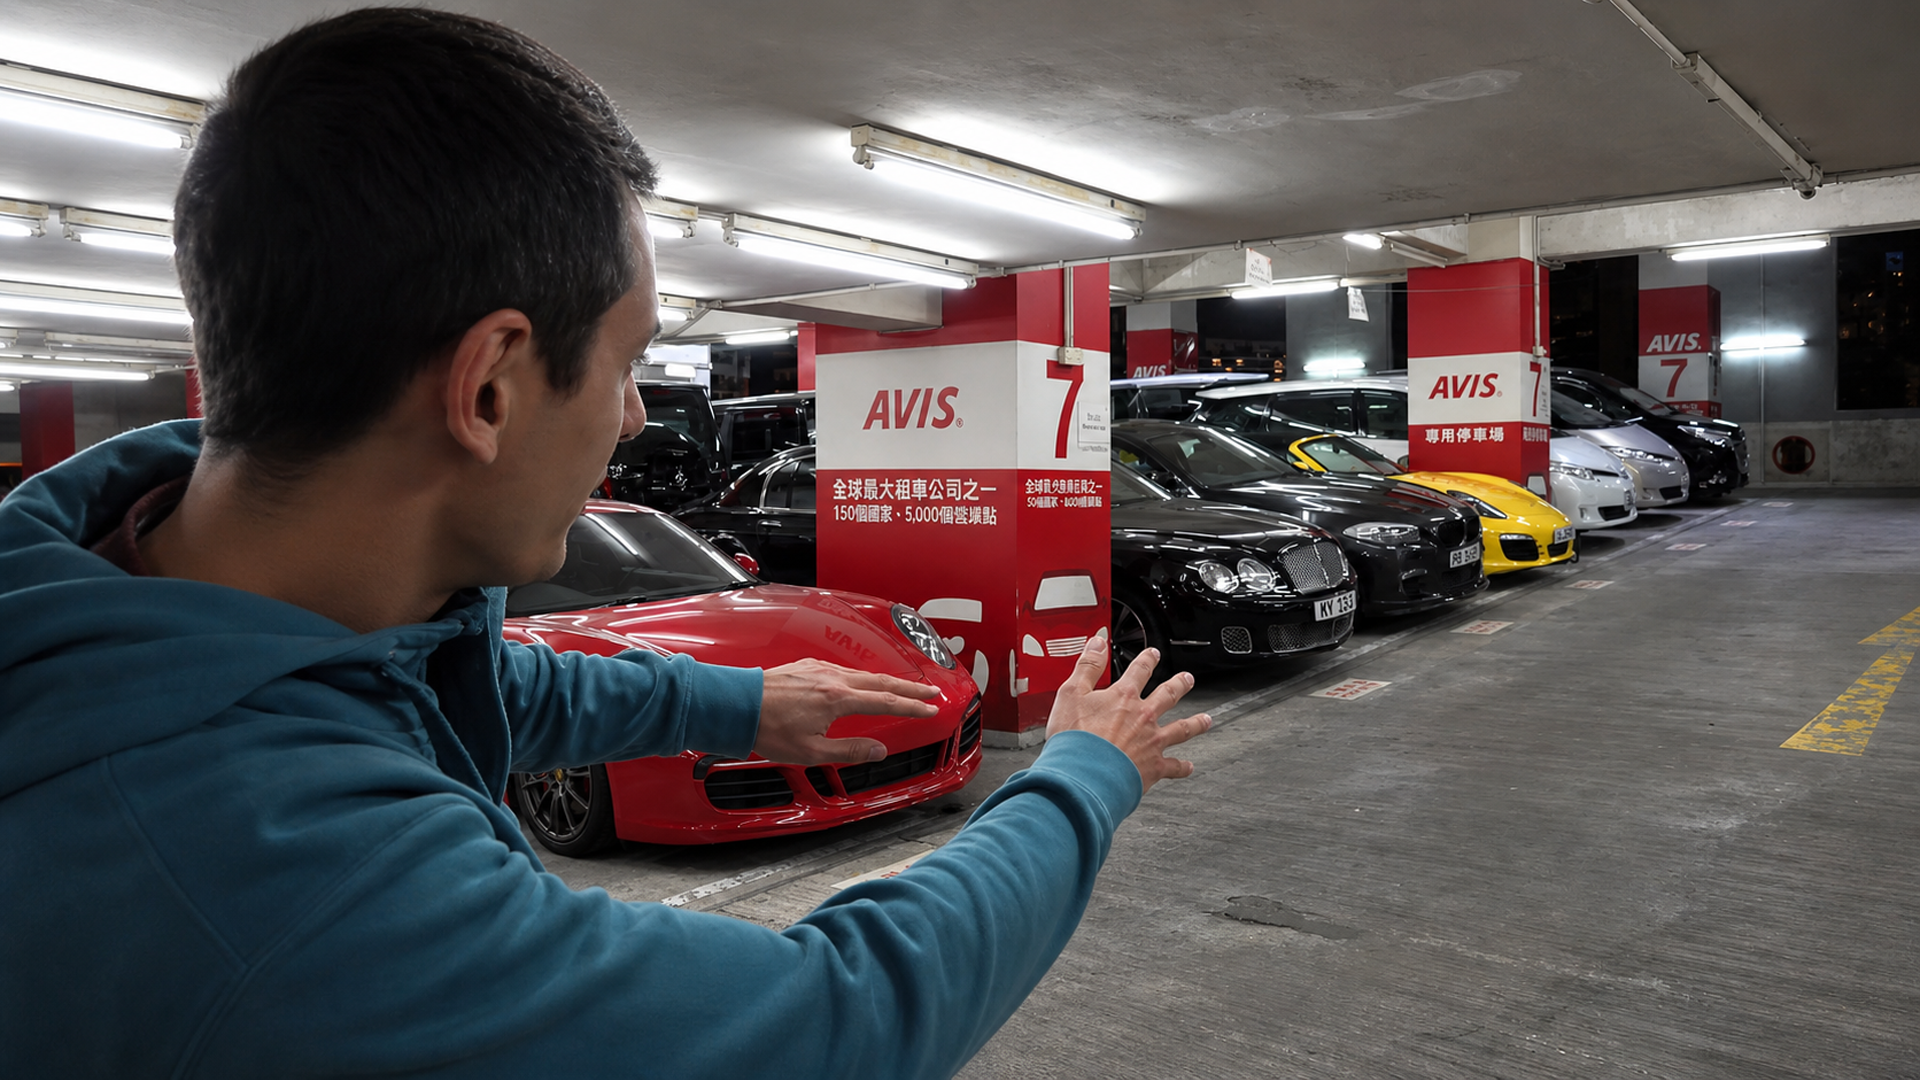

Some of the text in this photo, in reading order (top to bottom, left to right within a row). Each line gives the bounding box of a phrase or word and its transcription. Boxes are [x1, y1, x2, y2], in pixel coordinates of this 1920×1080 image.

[1428, 373, 1499, 400] AVIS
[1530, 361, 1542, 417] 7
[1661, 358, 1688, 398] 7
[862, 386, 960, 430] AVIS
[1046, 359, 1084, 459] 7
[833, 478, 997, 501] 全球最大租車公司之一
[1320, 599, 1333, 617] KY
